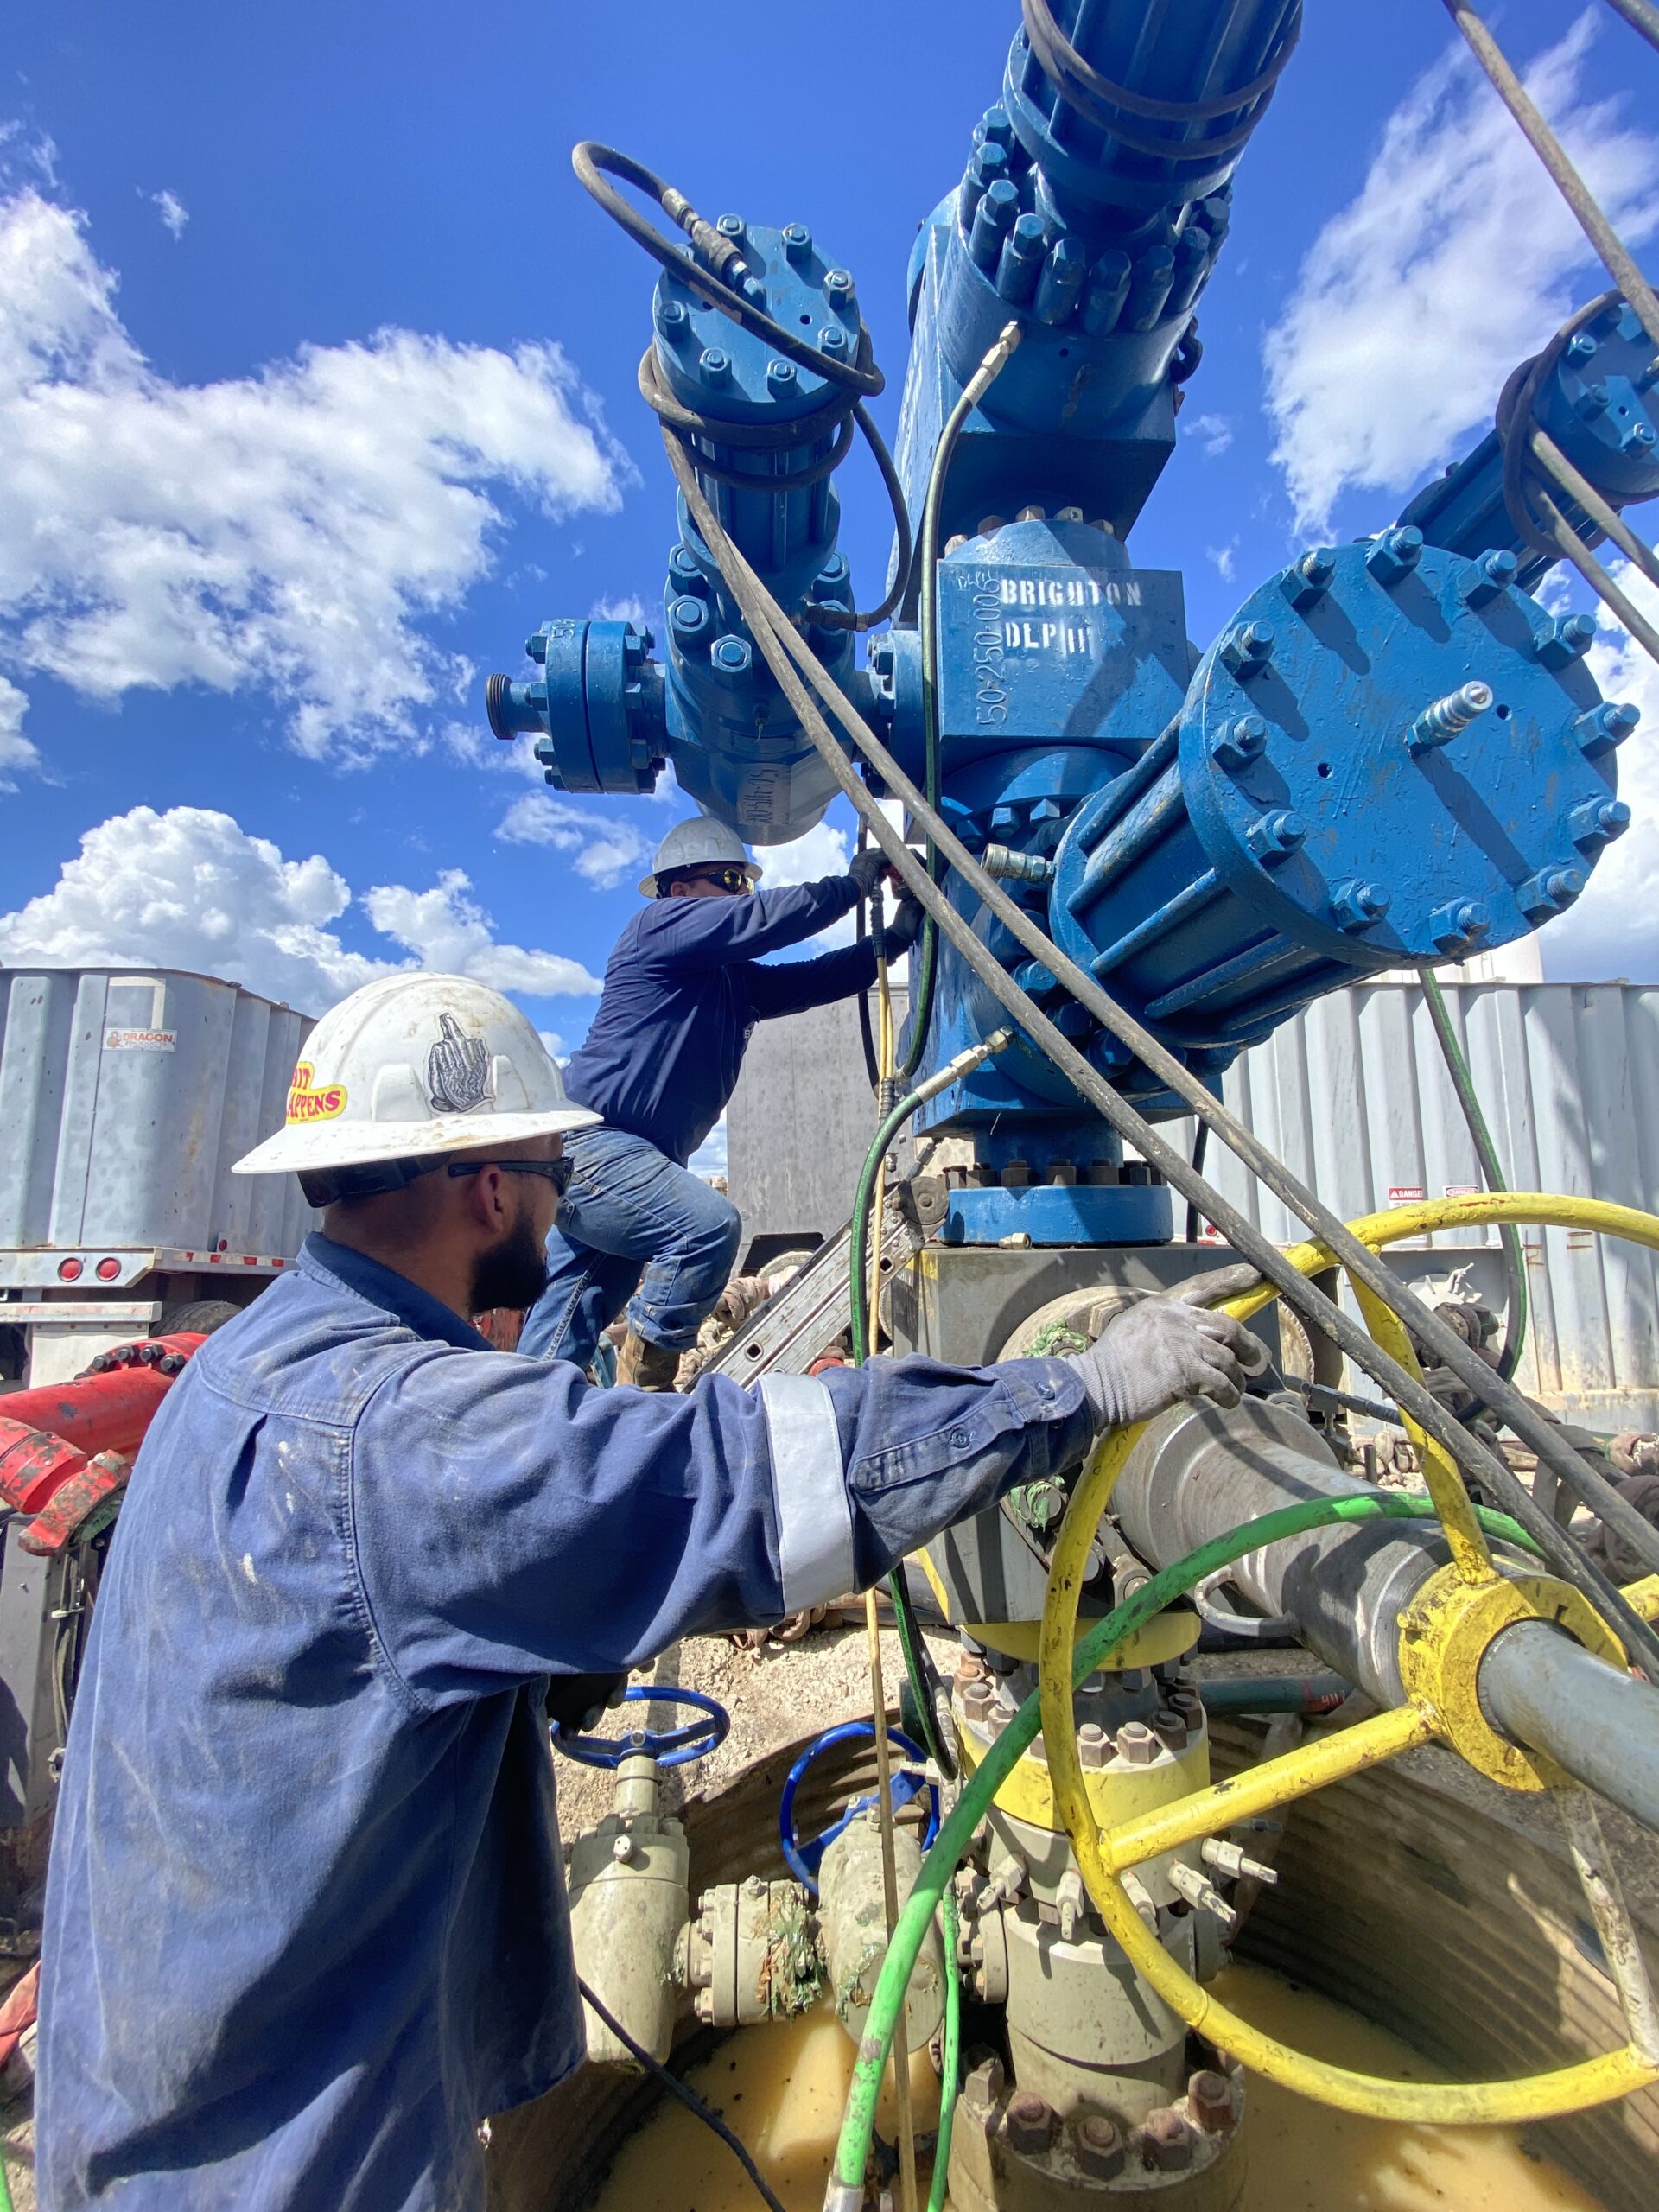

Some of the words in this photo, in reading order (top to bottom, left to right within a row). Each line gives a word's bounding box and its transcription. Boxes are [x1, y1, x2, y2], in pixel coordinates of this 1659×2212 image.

[1001, 579, 1141, 607] BRIGHTON
[123, 1033, 174, 1043] DRAGON
[1398, 1190, 1422, 1198] DANGE
